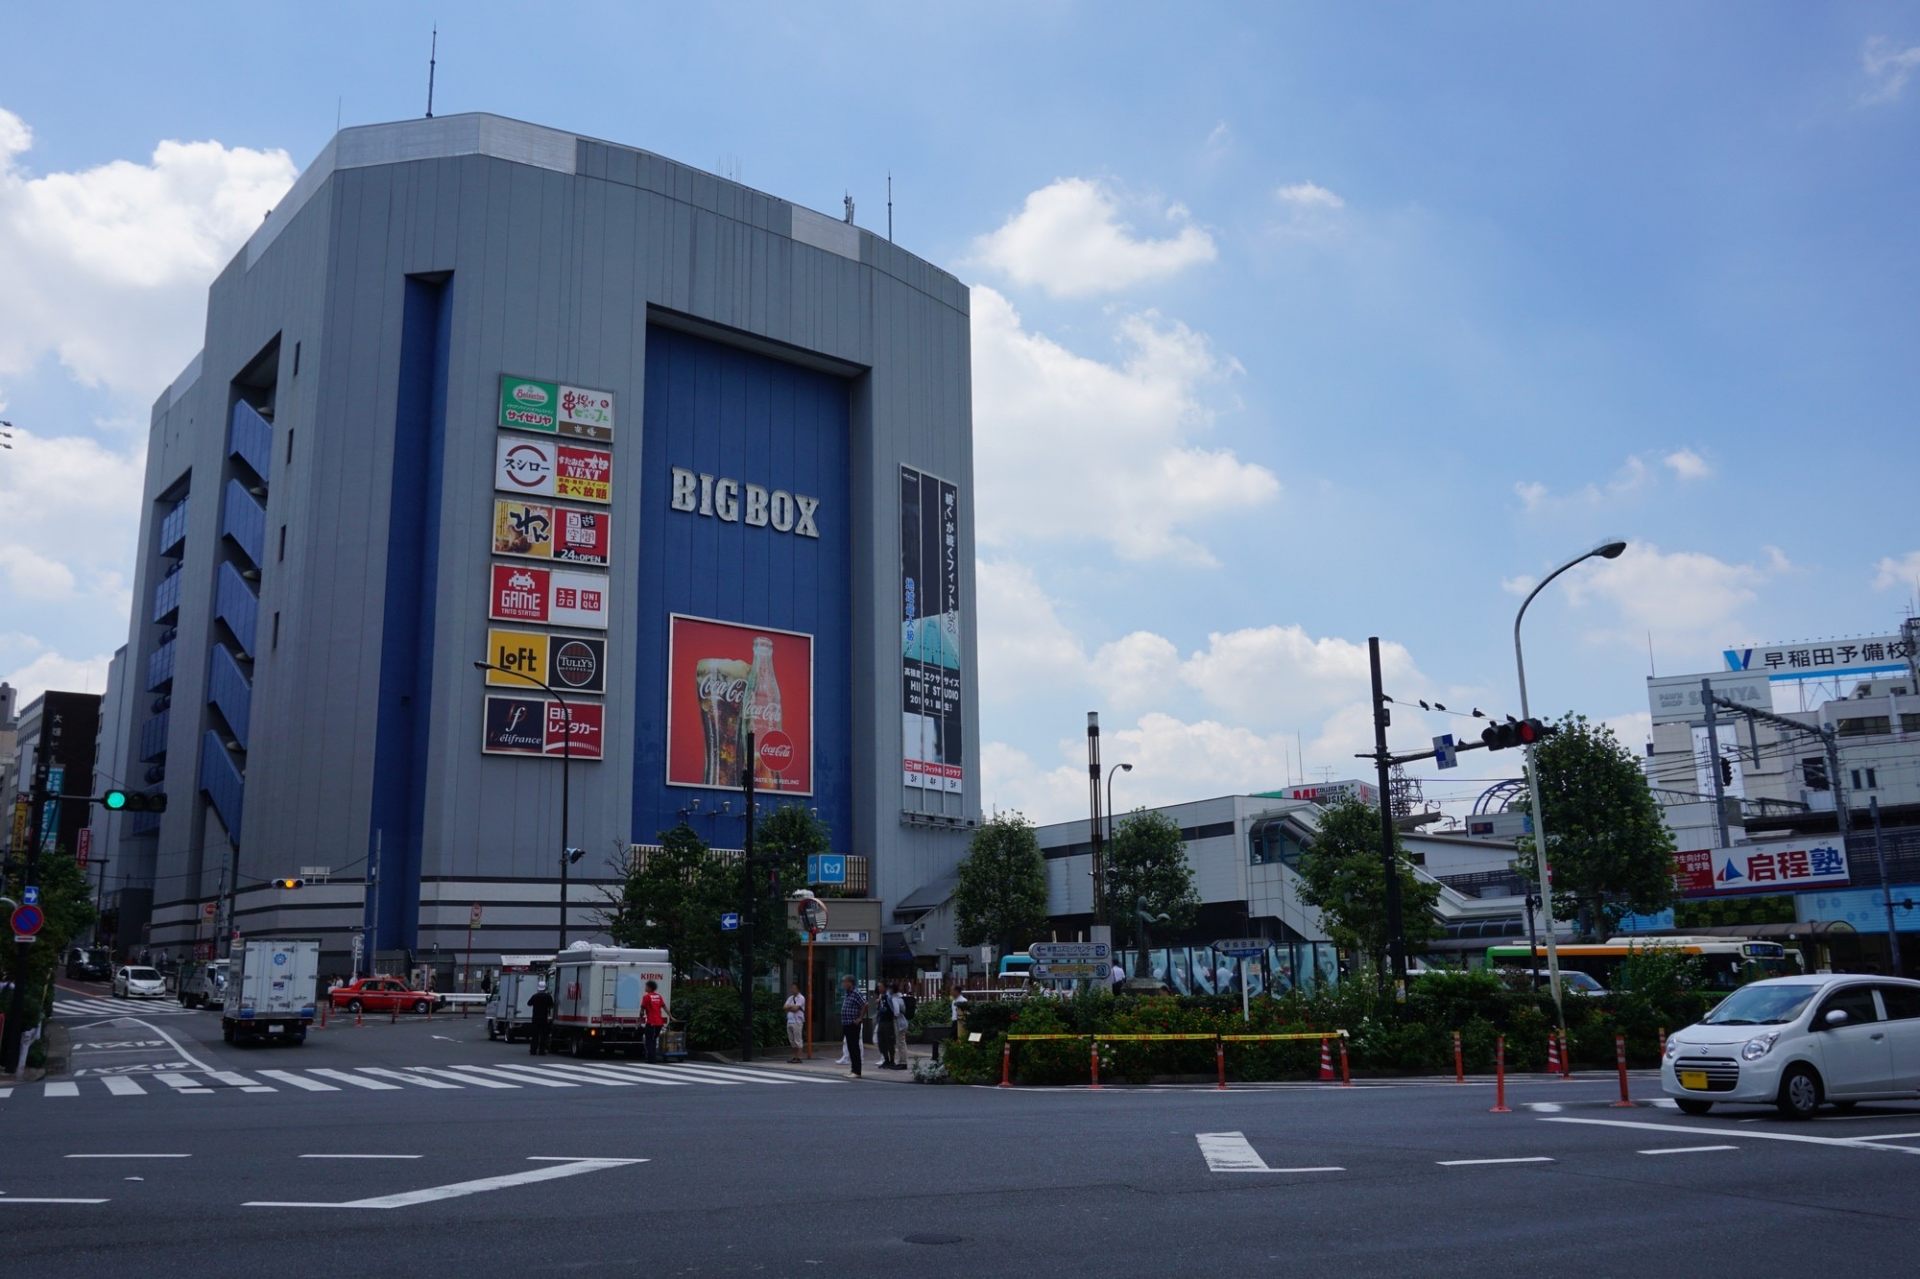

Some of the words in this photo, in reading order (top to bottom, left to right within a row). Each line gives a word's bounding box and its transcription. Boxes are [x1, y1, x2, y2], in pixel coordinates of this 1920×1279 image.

[506, 409, 553, 426] サイゼリヤ
[504, 458, 550, 472] スシロー
[565, 466, 602, 481] NEXT
[558, 483, 607, 500] 食べ放題
[671, 466, 739, 522] BIG
[745, 482, 820, 538] BOX
[509, 507, 550, 543] わん
[501, 590, 541, 611] GAME
[559, 590, 574, 598] ユニ
[583, 593, 598, 601] UNI
[558, 599, 573, 607] クロ
[582, 601, 599, 609] QLO
[1764, 640, 1911, 670] 早稲田予備校
[1688, 686, 1761, 706] SZUYA
[550, 707, 573, 721] 日産
[548, 721, 599, 735] レンタカー
